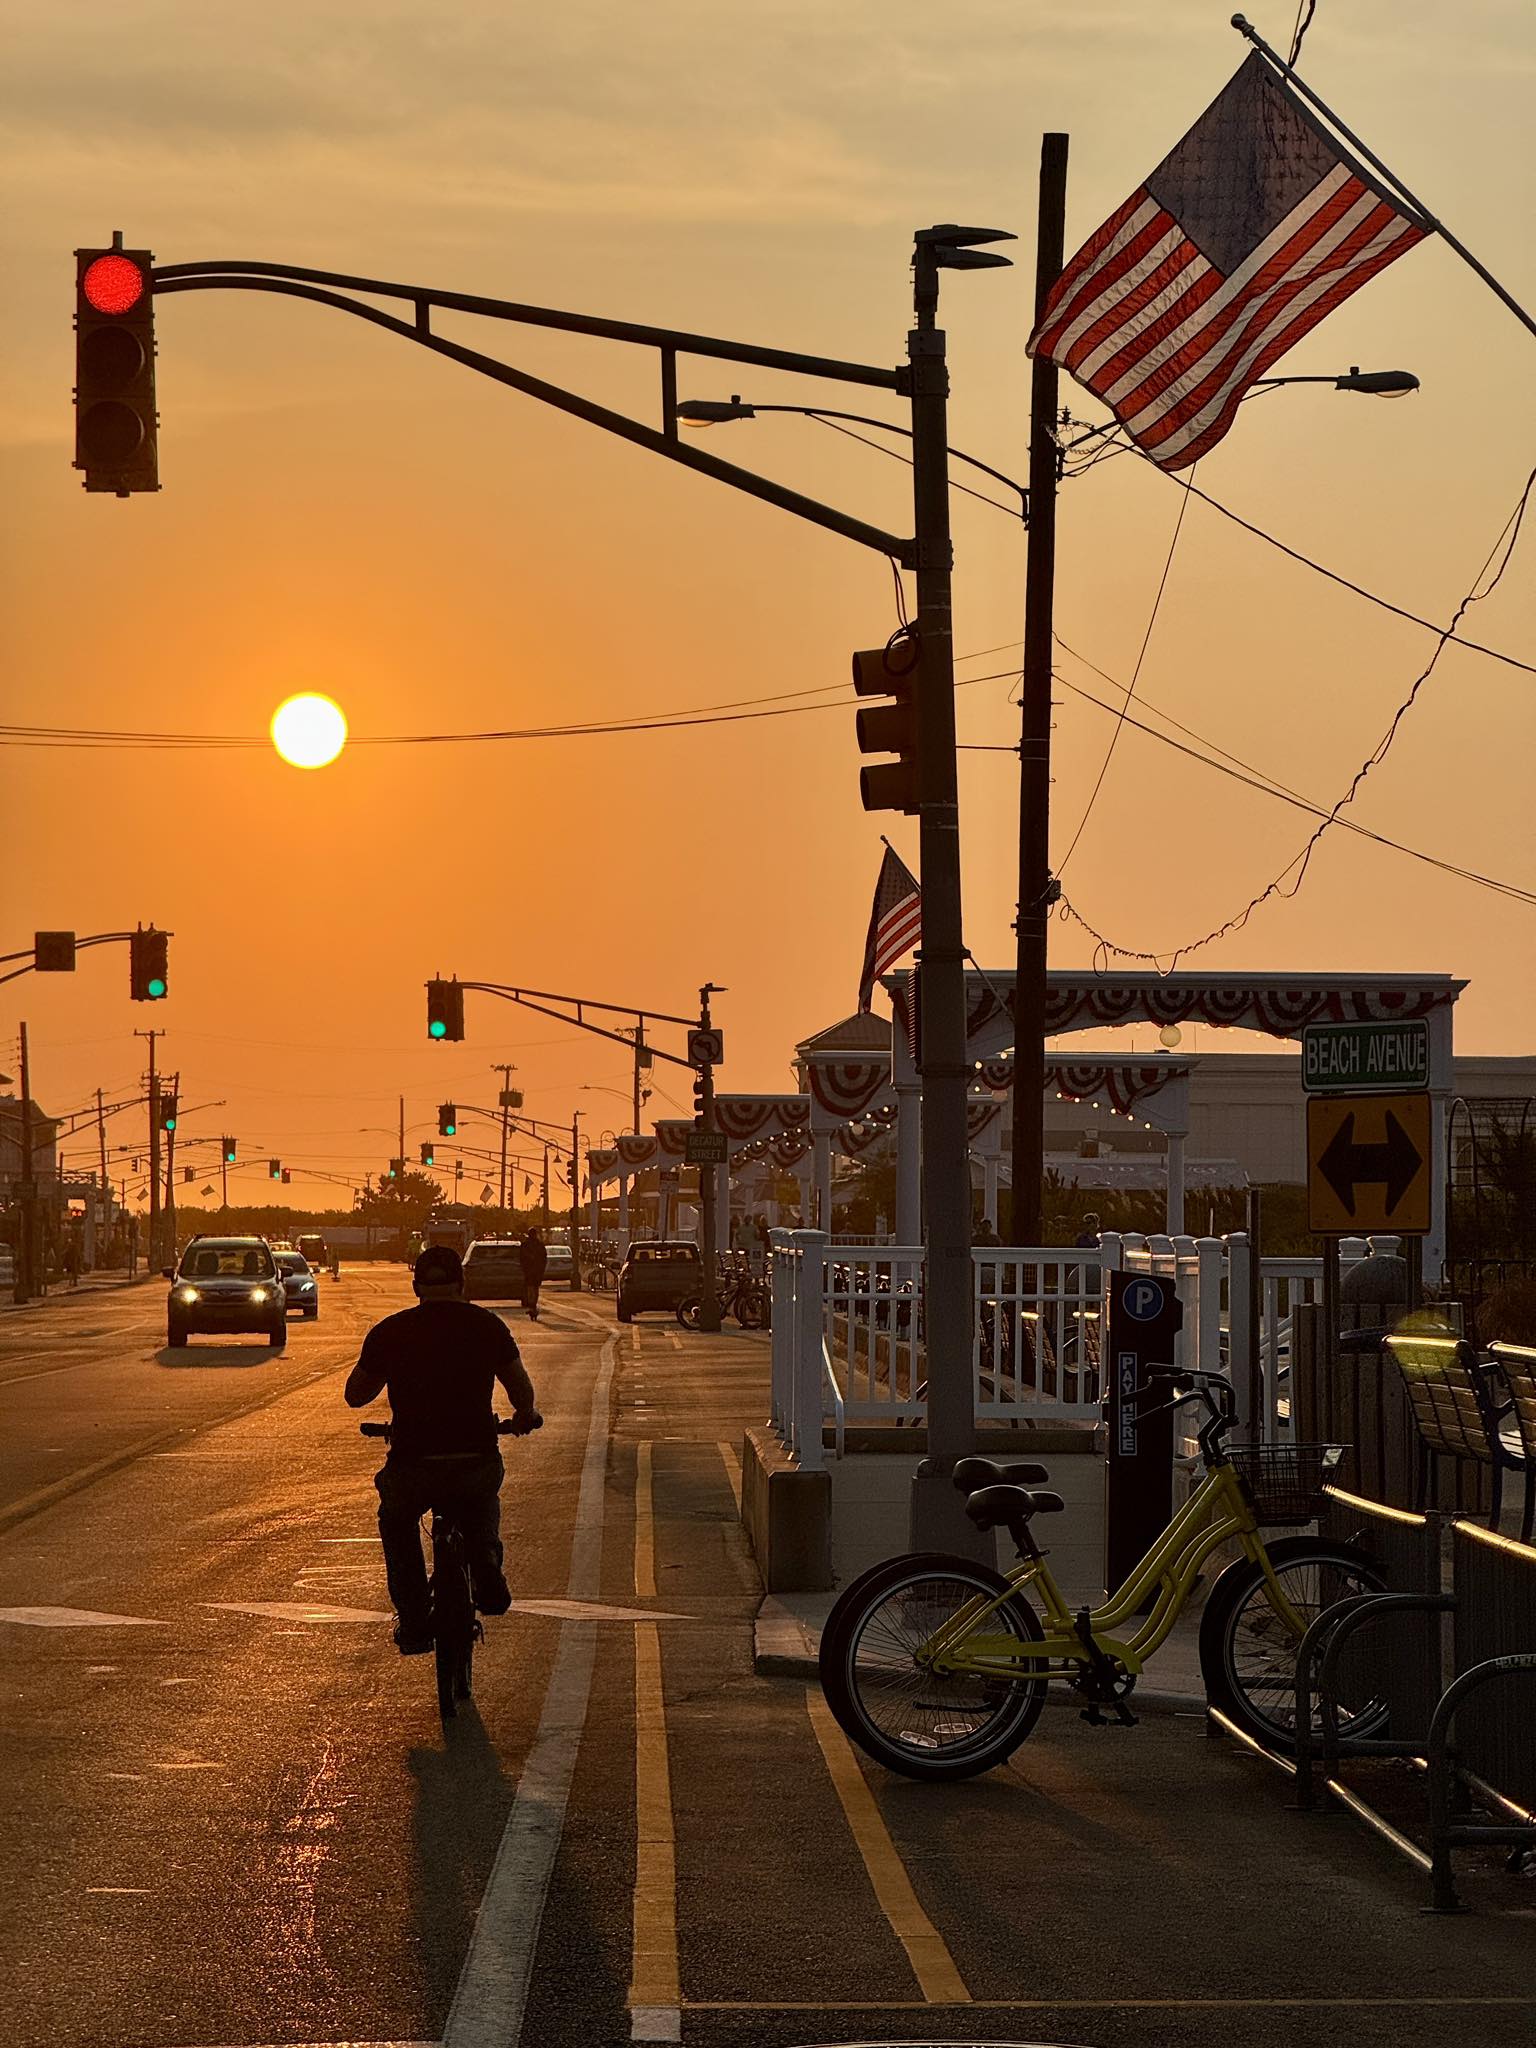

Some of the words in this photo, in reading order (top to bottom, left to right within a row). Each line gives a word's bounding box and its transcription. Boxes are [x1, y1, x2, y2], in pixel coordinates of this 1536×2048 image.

[1307, 1036, 1360, 1074] BEACH
[1366, 1033, 1425, 1072] AVENUE
[689, 1135, 724, 1146] DECATUR
[691, 1150, 721, 1160] STREET
[1136, 1286, 1154, 1314] P
[1122, 1356, 1134, 1393] PAY
